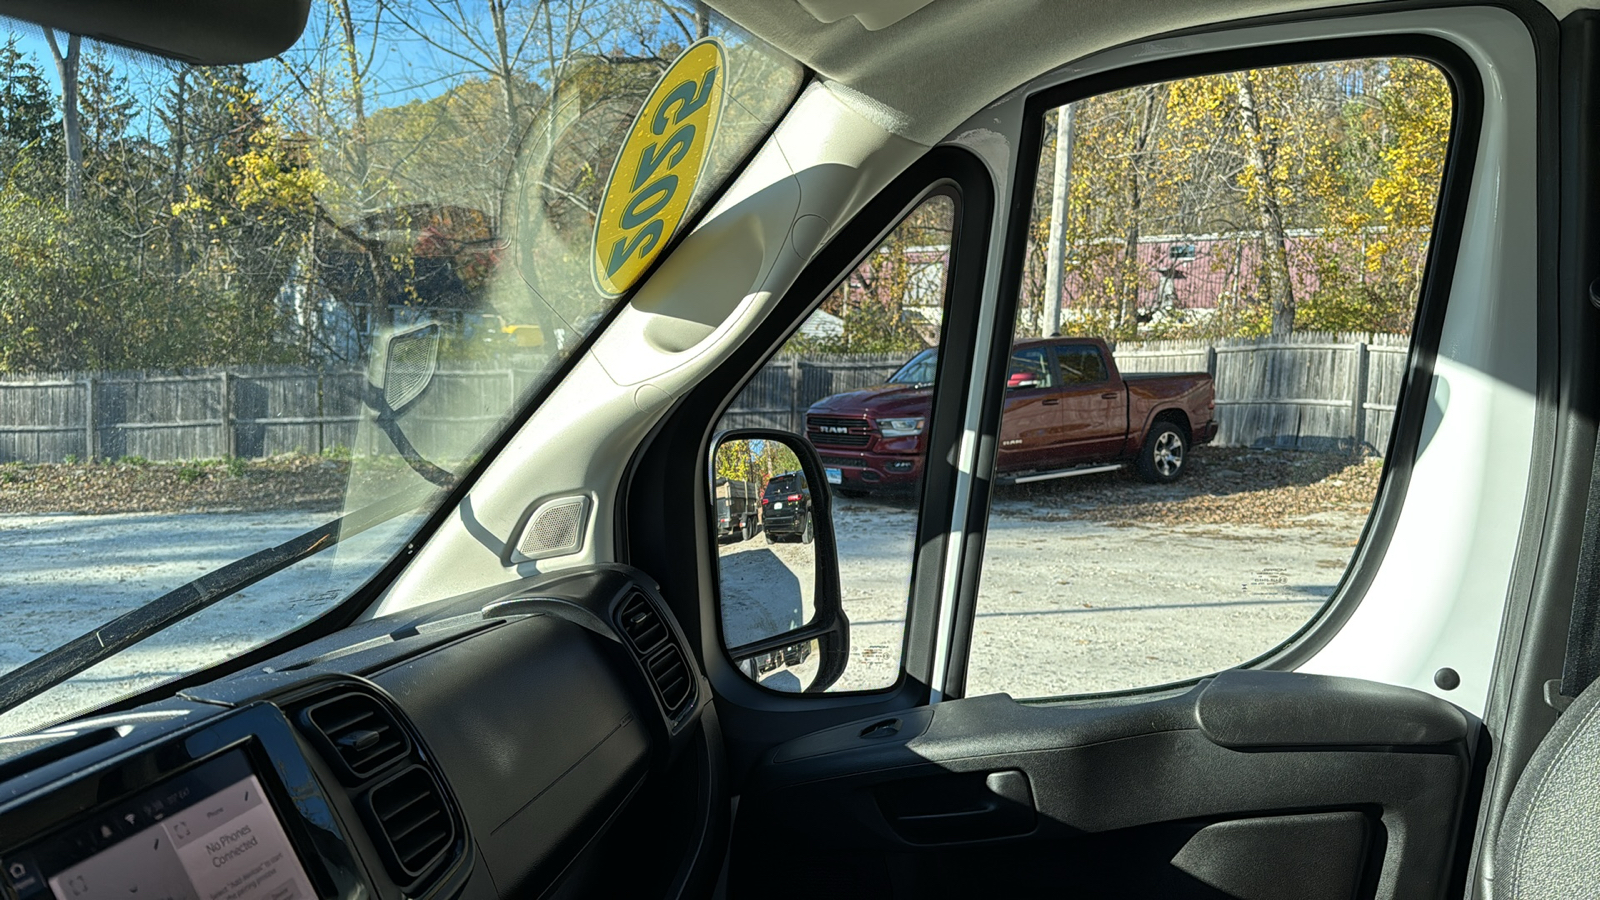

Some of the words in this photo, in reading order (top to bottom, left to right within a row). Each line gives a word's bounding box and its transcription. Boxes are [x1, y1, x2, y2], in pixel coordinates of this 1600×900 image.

[820, 426, 848, 434] RAM
[206, 842, 221, 855] No
[219, 825, 252, 847] Phones
[212, 835, 258, 868] Connected
